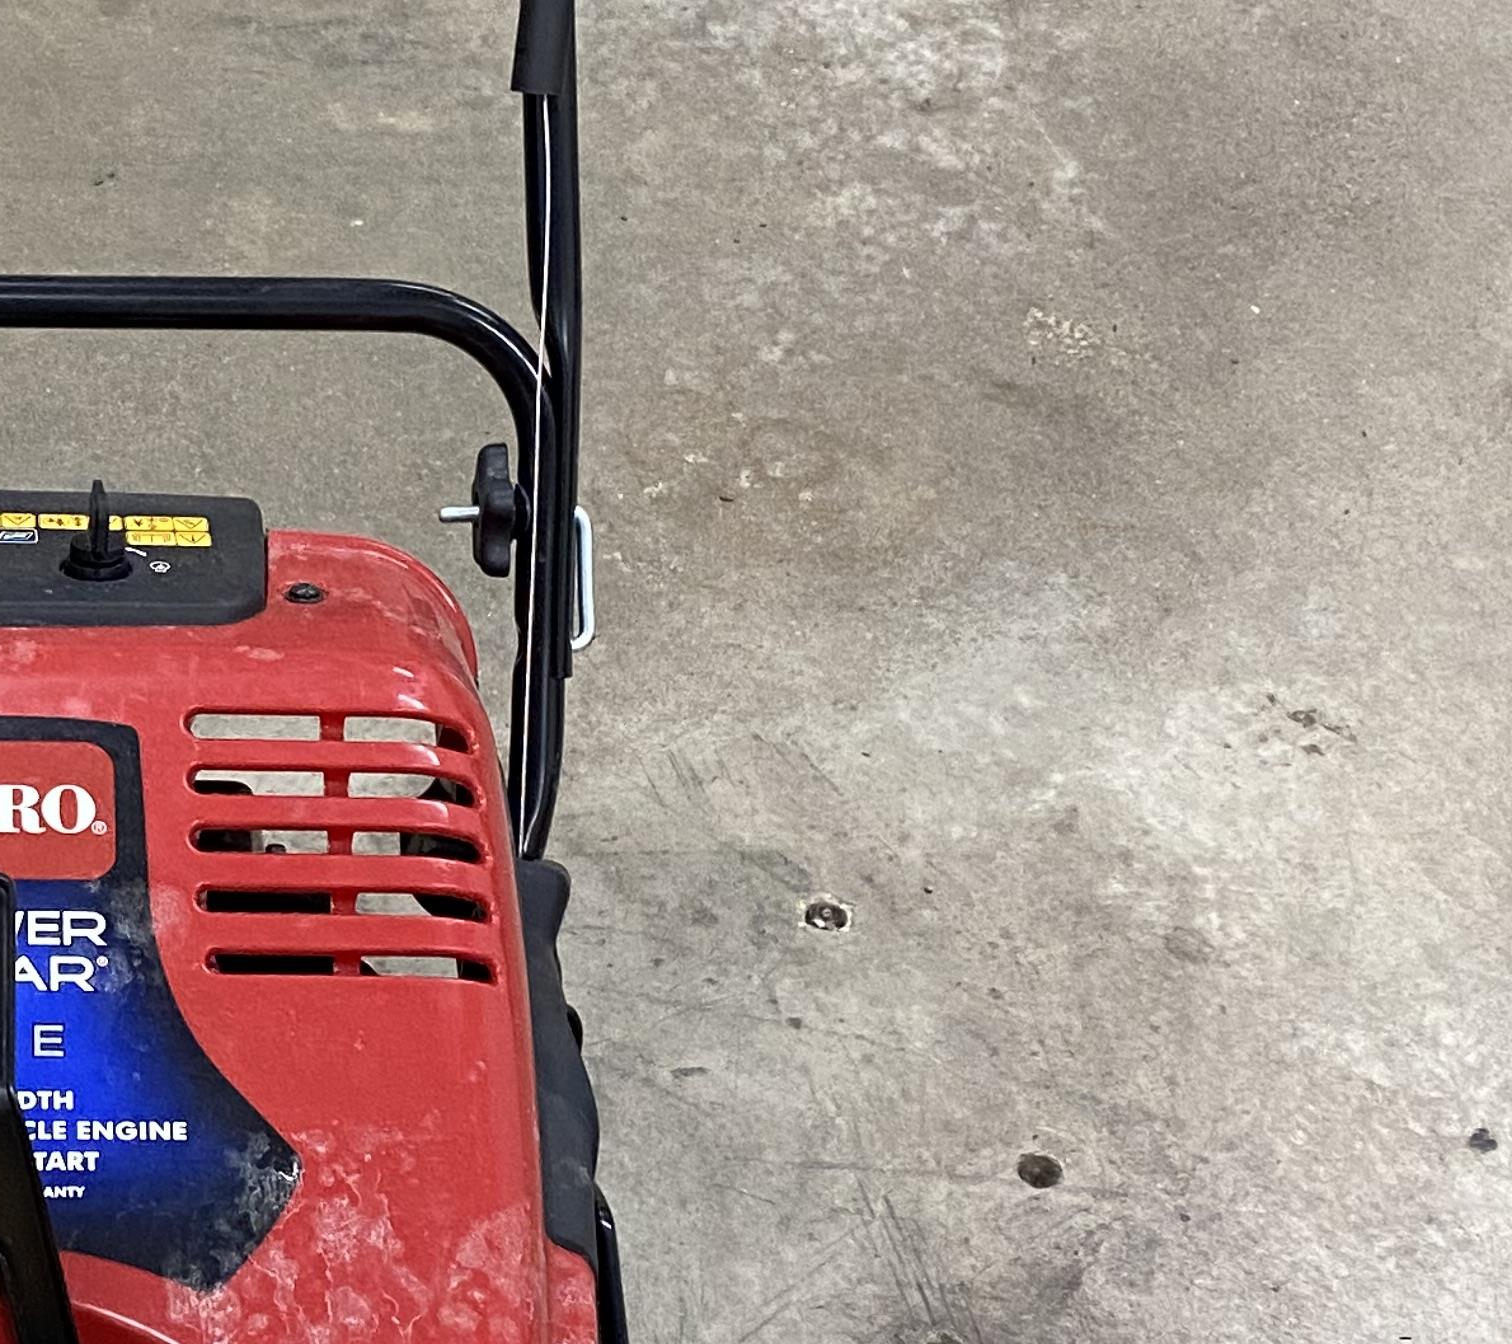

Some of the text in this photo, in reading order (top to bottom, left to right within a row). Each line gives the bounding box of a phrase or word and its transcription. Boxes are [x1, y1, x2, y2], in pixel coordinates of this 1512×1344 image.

[17, 1090, 74, 1110] DTH
[76, 1120, 188, 1141] ENGINE
[33, 1151, 100, 1171] TART
